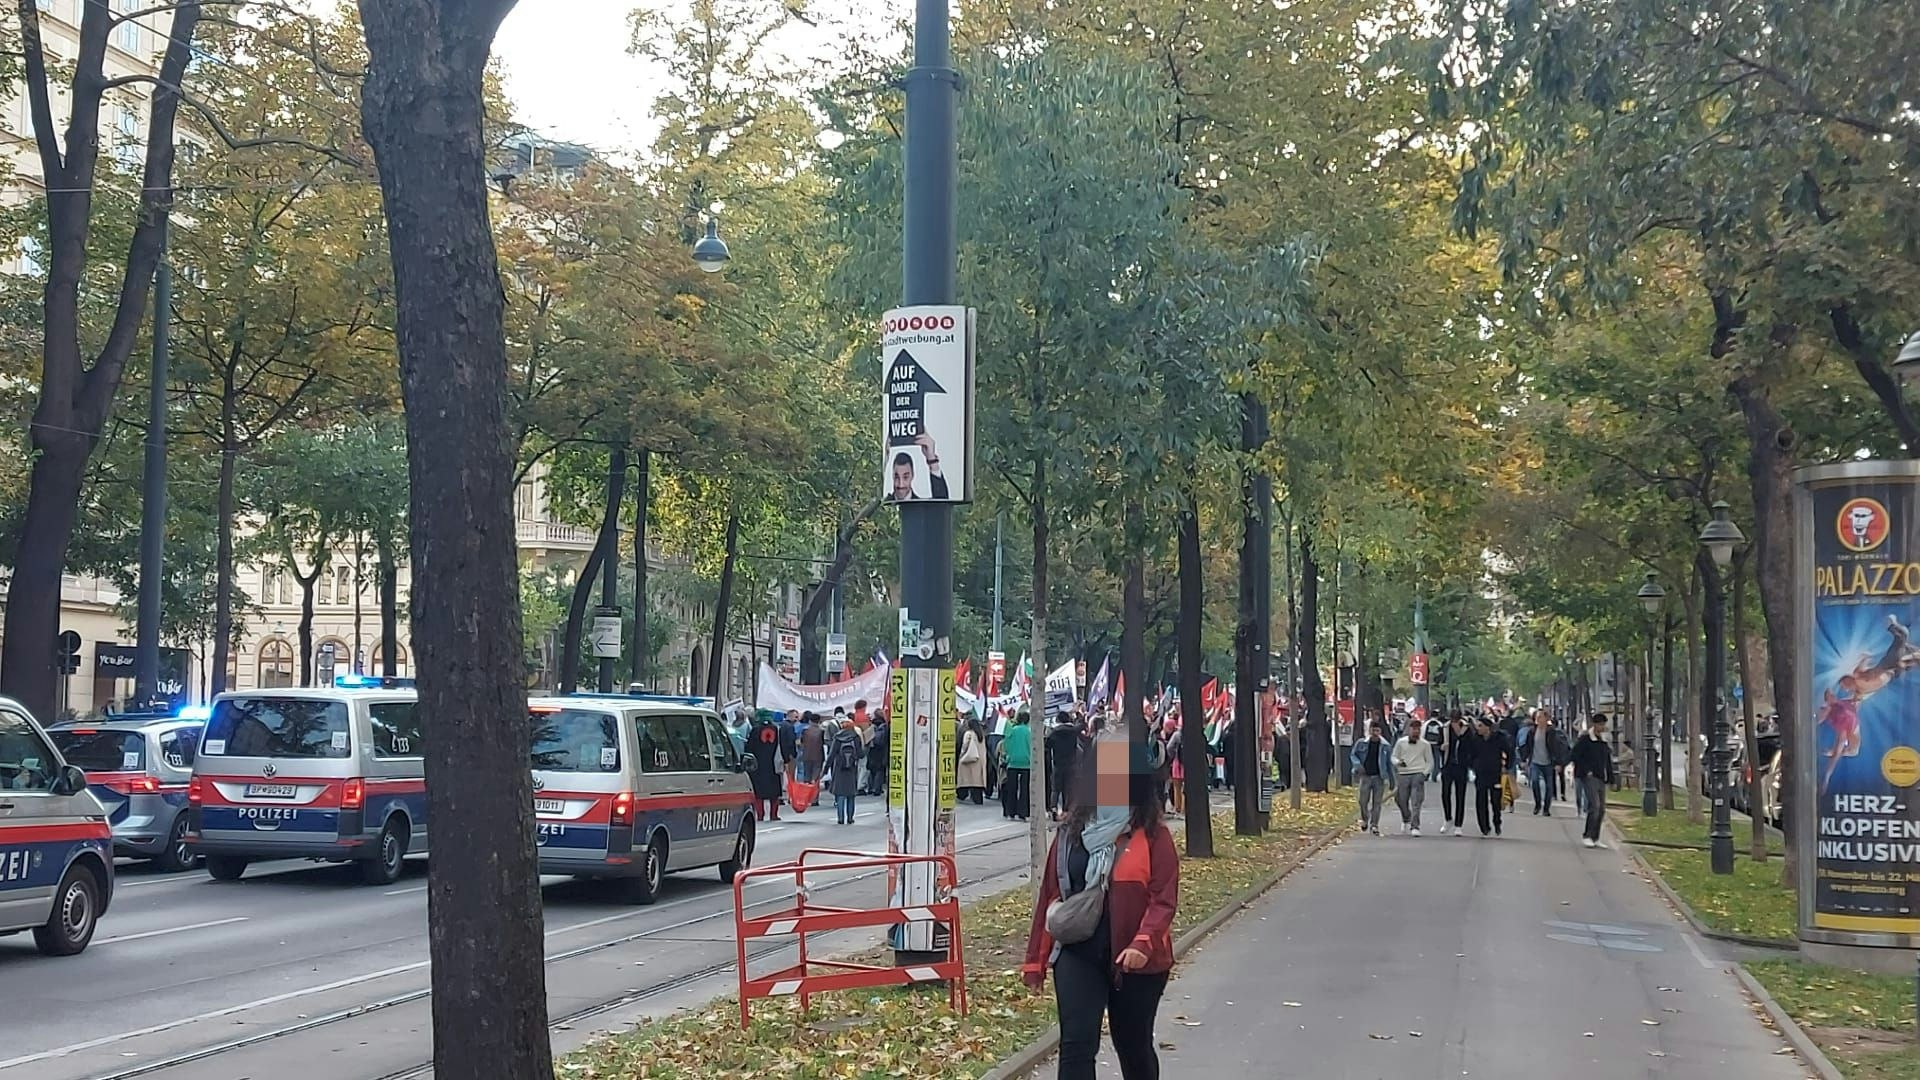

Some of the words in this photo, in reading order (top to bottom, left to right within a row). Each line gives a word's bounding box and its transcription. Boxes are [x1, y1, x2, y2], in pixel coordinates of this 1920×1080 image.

[892, 365, 916, 381] AUF
[891, 381, 918, 395] DAUER
[895, 396, 910, 407] DER
[891, 422, 917, 437] WEG
[1817, 563, 1920, 598] PALAZZO
[396, 737, 410, 753] 133
[169, 754, 183, 766] 133
[659, 751, 669, 767] 133
[1834, 794, 1906, 814] HERZ-
[238, 808, 298, 820] POLIZEI
[696, 809, 729, 833] POLIZEI
[1821, 816, 1920, 838] KLOPFEN
